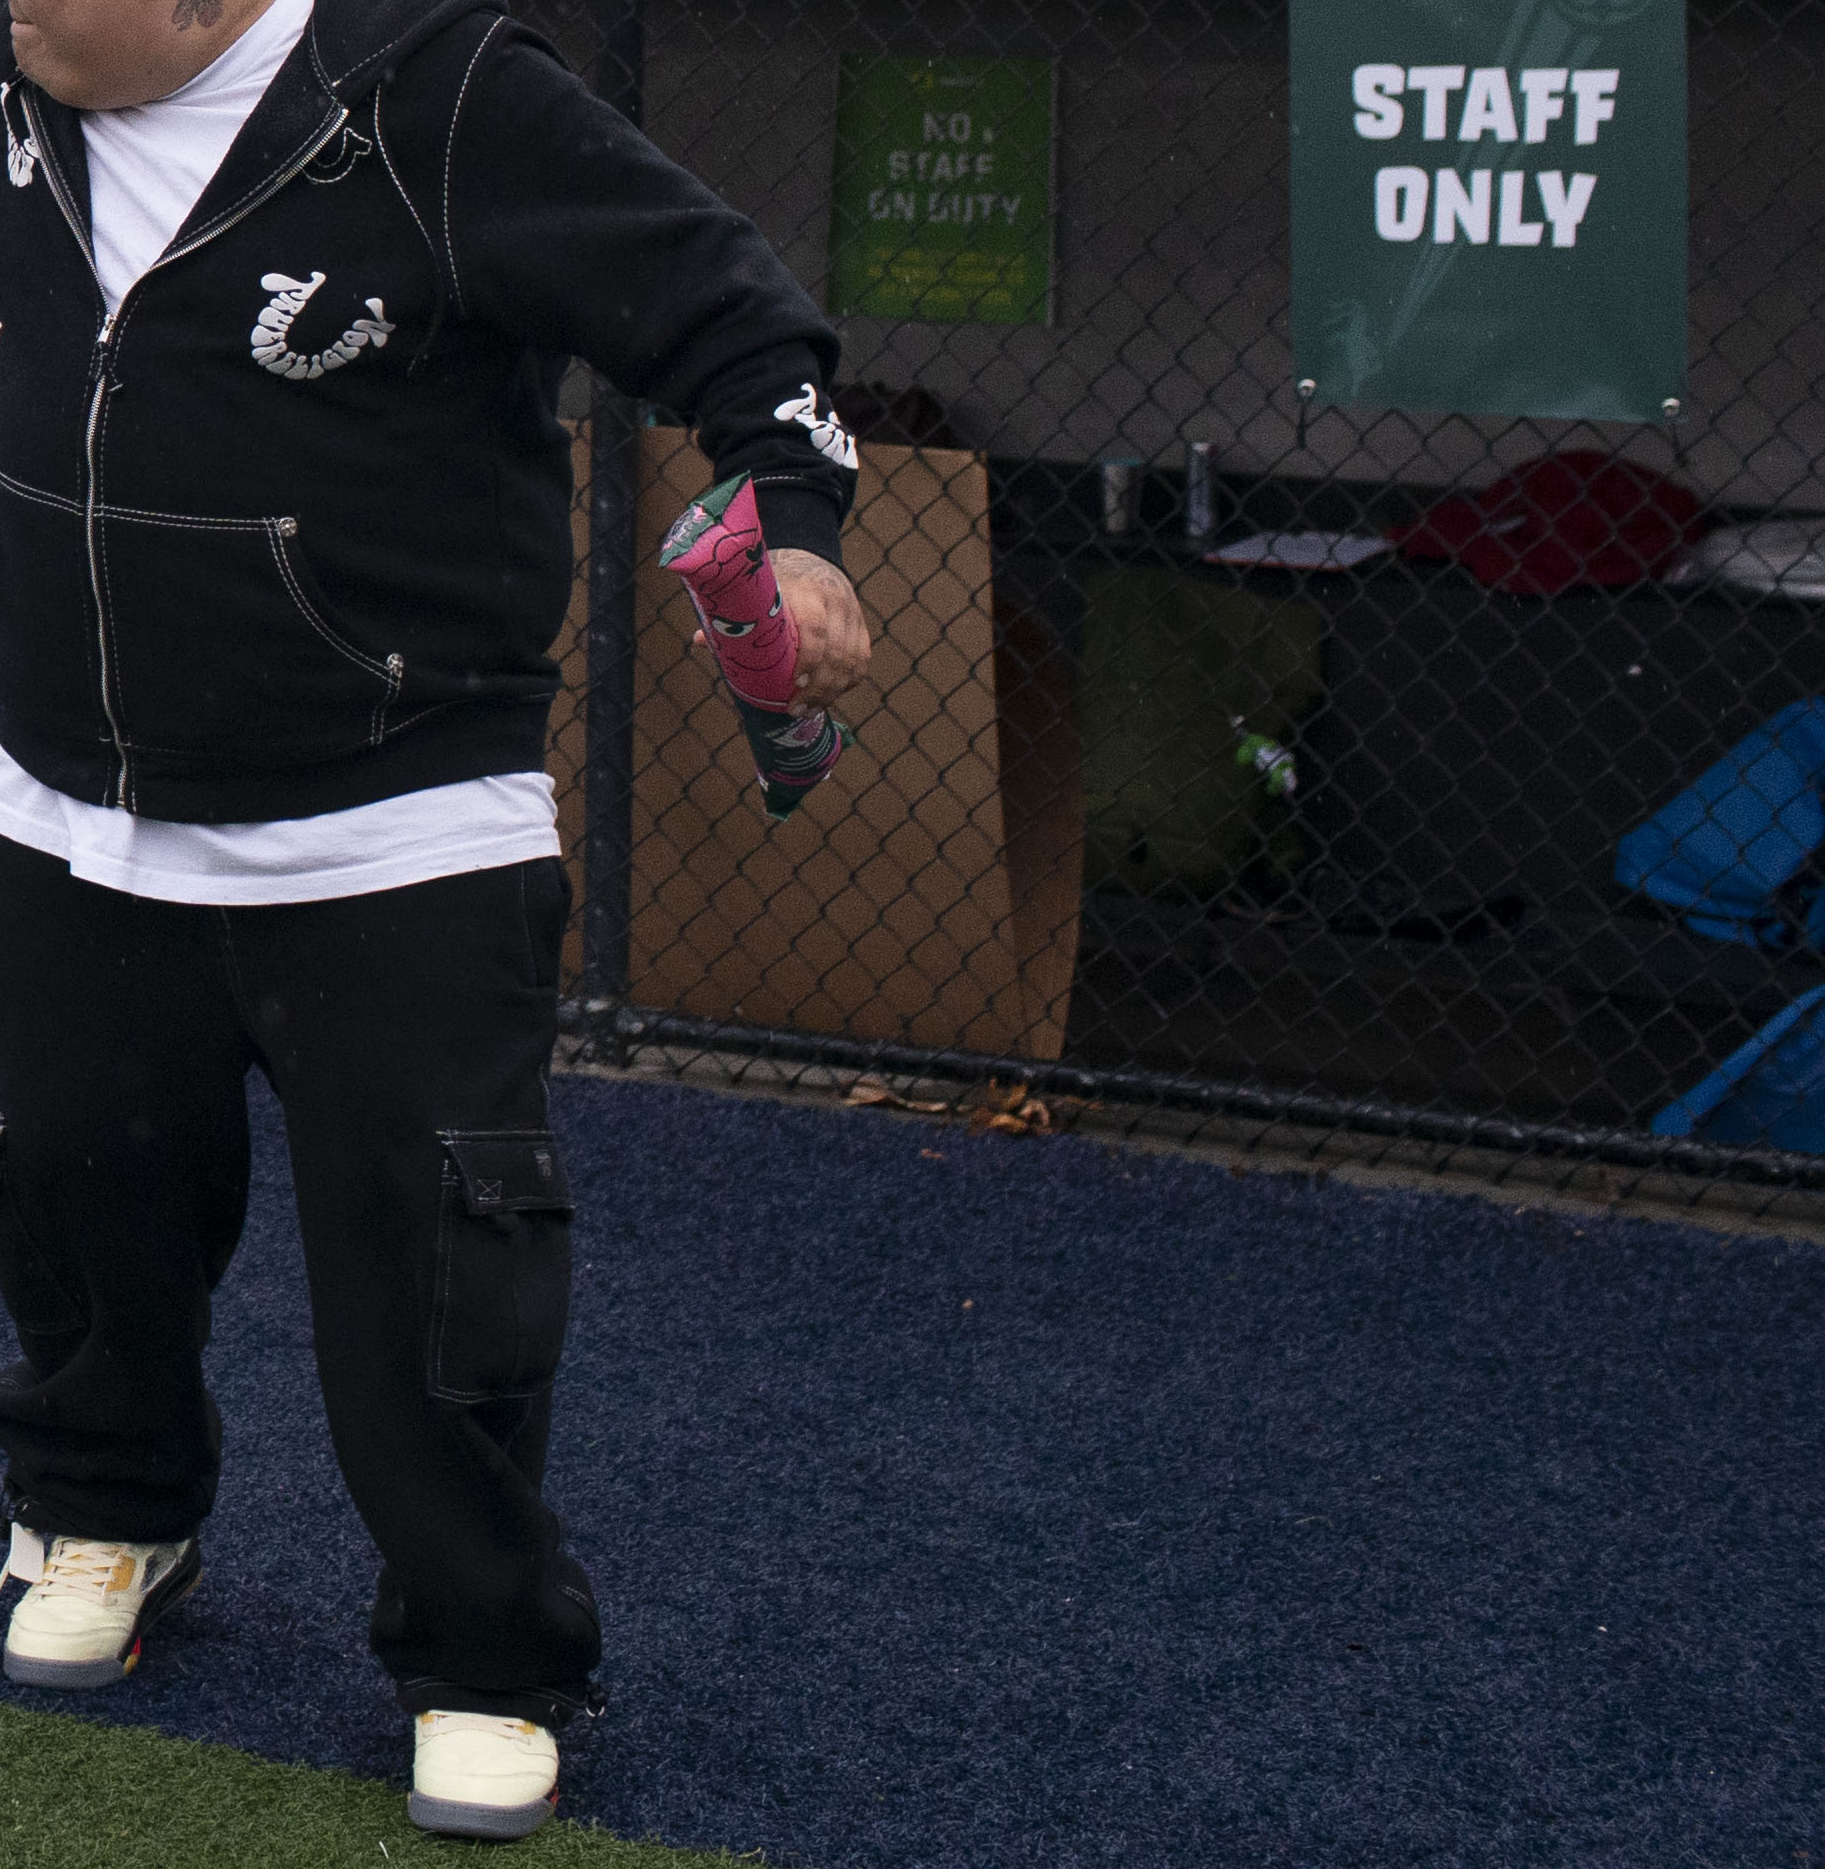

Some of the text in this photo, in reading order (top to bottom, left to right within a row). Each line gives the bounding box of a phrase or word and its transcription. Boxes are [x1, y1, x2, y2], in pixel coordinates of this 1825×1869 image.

[923, 111, 971, 143] NO
[1352, 63, 1620, 146] STAFF
[890, 150, 995, 181] STAFF
[867, 189, 1022, 225] ON DUTY
[1374, 165, 1598, 248] ONLY
[251, 271, 397, 380] TRUE RELIGION
